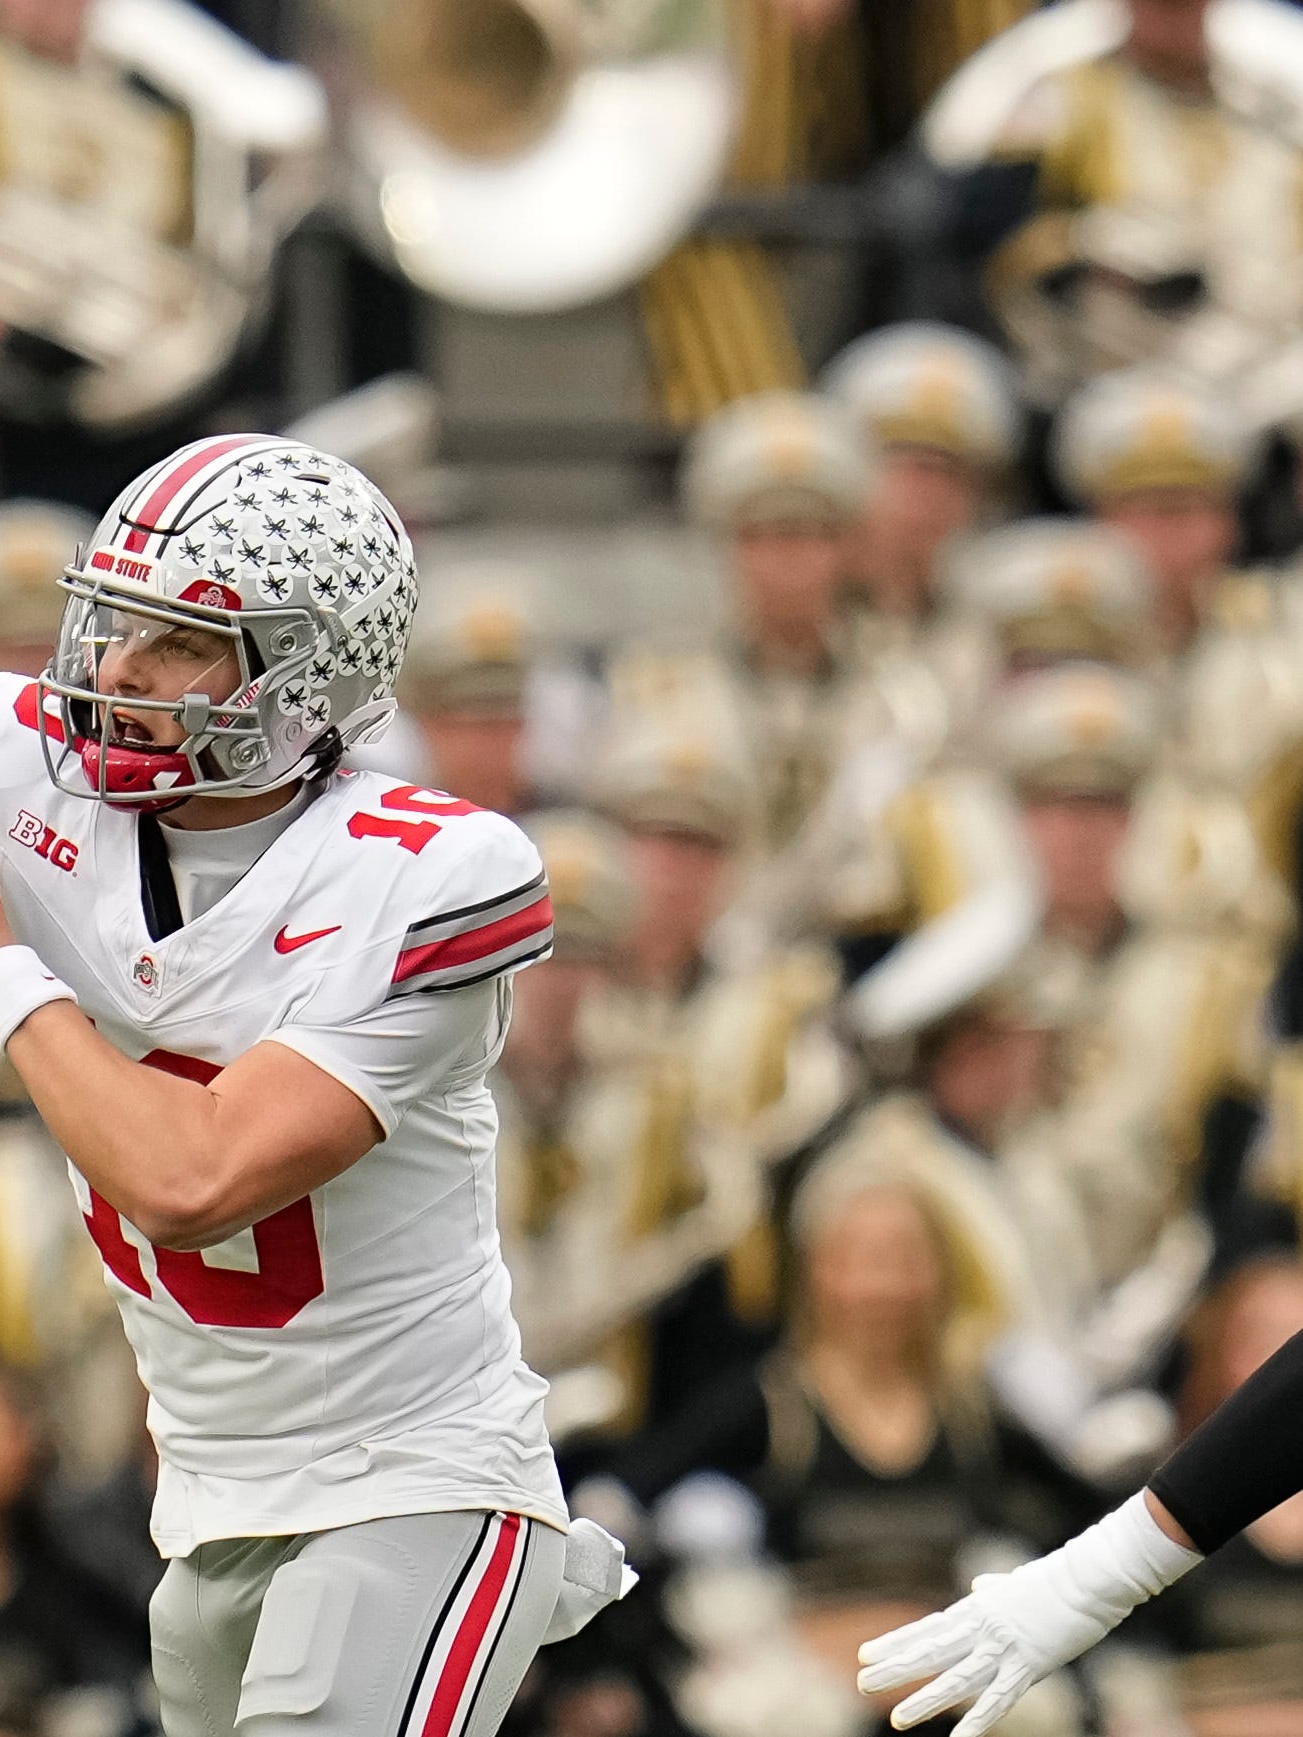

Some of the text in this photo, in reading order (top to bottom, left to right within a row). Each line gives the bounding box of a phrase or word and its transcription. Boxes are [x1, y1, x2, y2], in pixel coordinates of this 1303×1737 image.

[115, 558, 152, 583] STATE
[9, 809, 78, 872] BIG
[347, 785, 490, 855] 10
